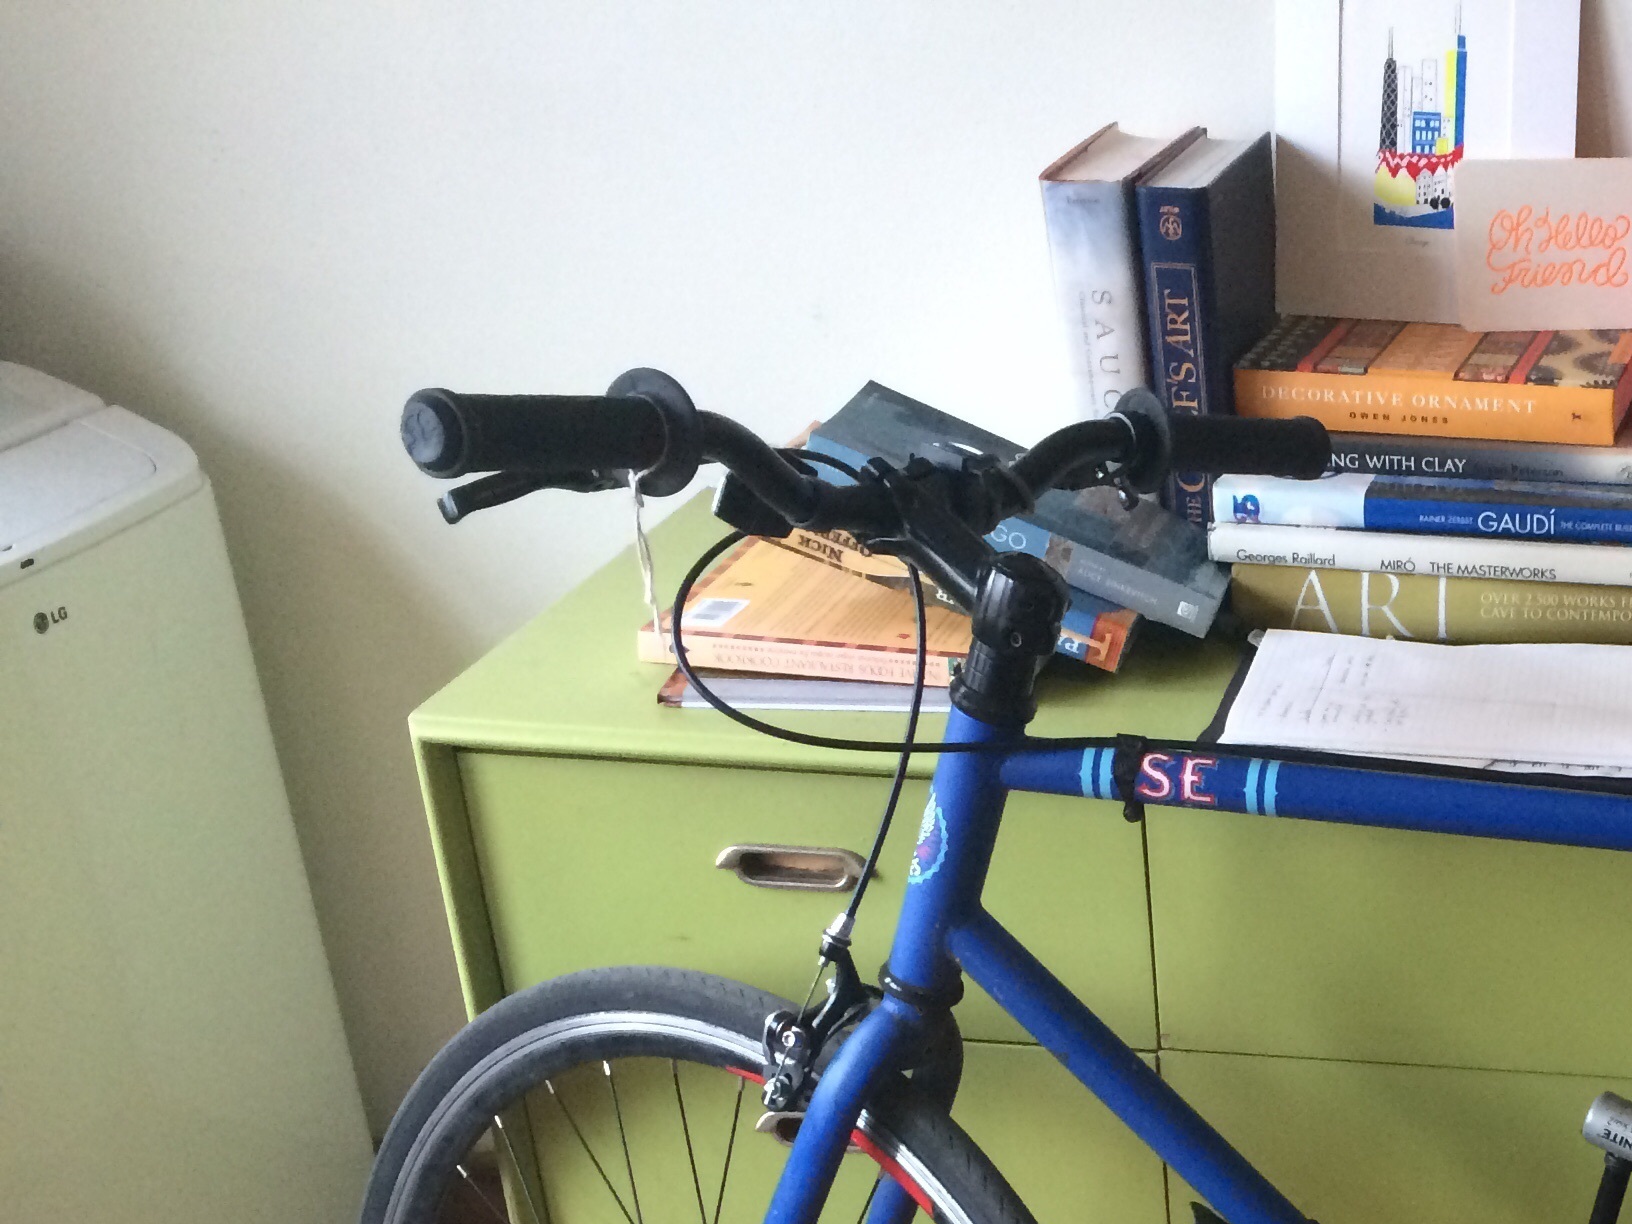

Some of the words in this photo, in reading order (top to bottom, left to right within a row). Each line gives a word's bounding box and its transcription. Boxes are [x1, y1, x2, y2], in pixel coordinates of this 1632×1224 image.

[1535, 206, 1631, 254] Hello
[1487, 246, 1629, 295] Friend
[1261, 385, 1402, 407] DECORATIVE
[1411, 394, 1537, 414] ORNAMENT
[1348, 411, 1391, 422] OWEN
[1401, 413, 1449, 425] JONES
[1365, 455, 1416, 471] WITH
[1421, 457, 1467, 474] CLAY
[1236, 549, 1288, 565] Georges
[1292, 552, 1336, 568] Raillard
[1429, 561, 1453, 575] THE
[1457, 565, 1557, 581] MASTERWORKS
[1562, 595, 1616, 608] WORKS
[50, 606, 68, 625] LG
[1523, 608, 1542, 621] TO
[1138, 751, 1217, 804] SE
